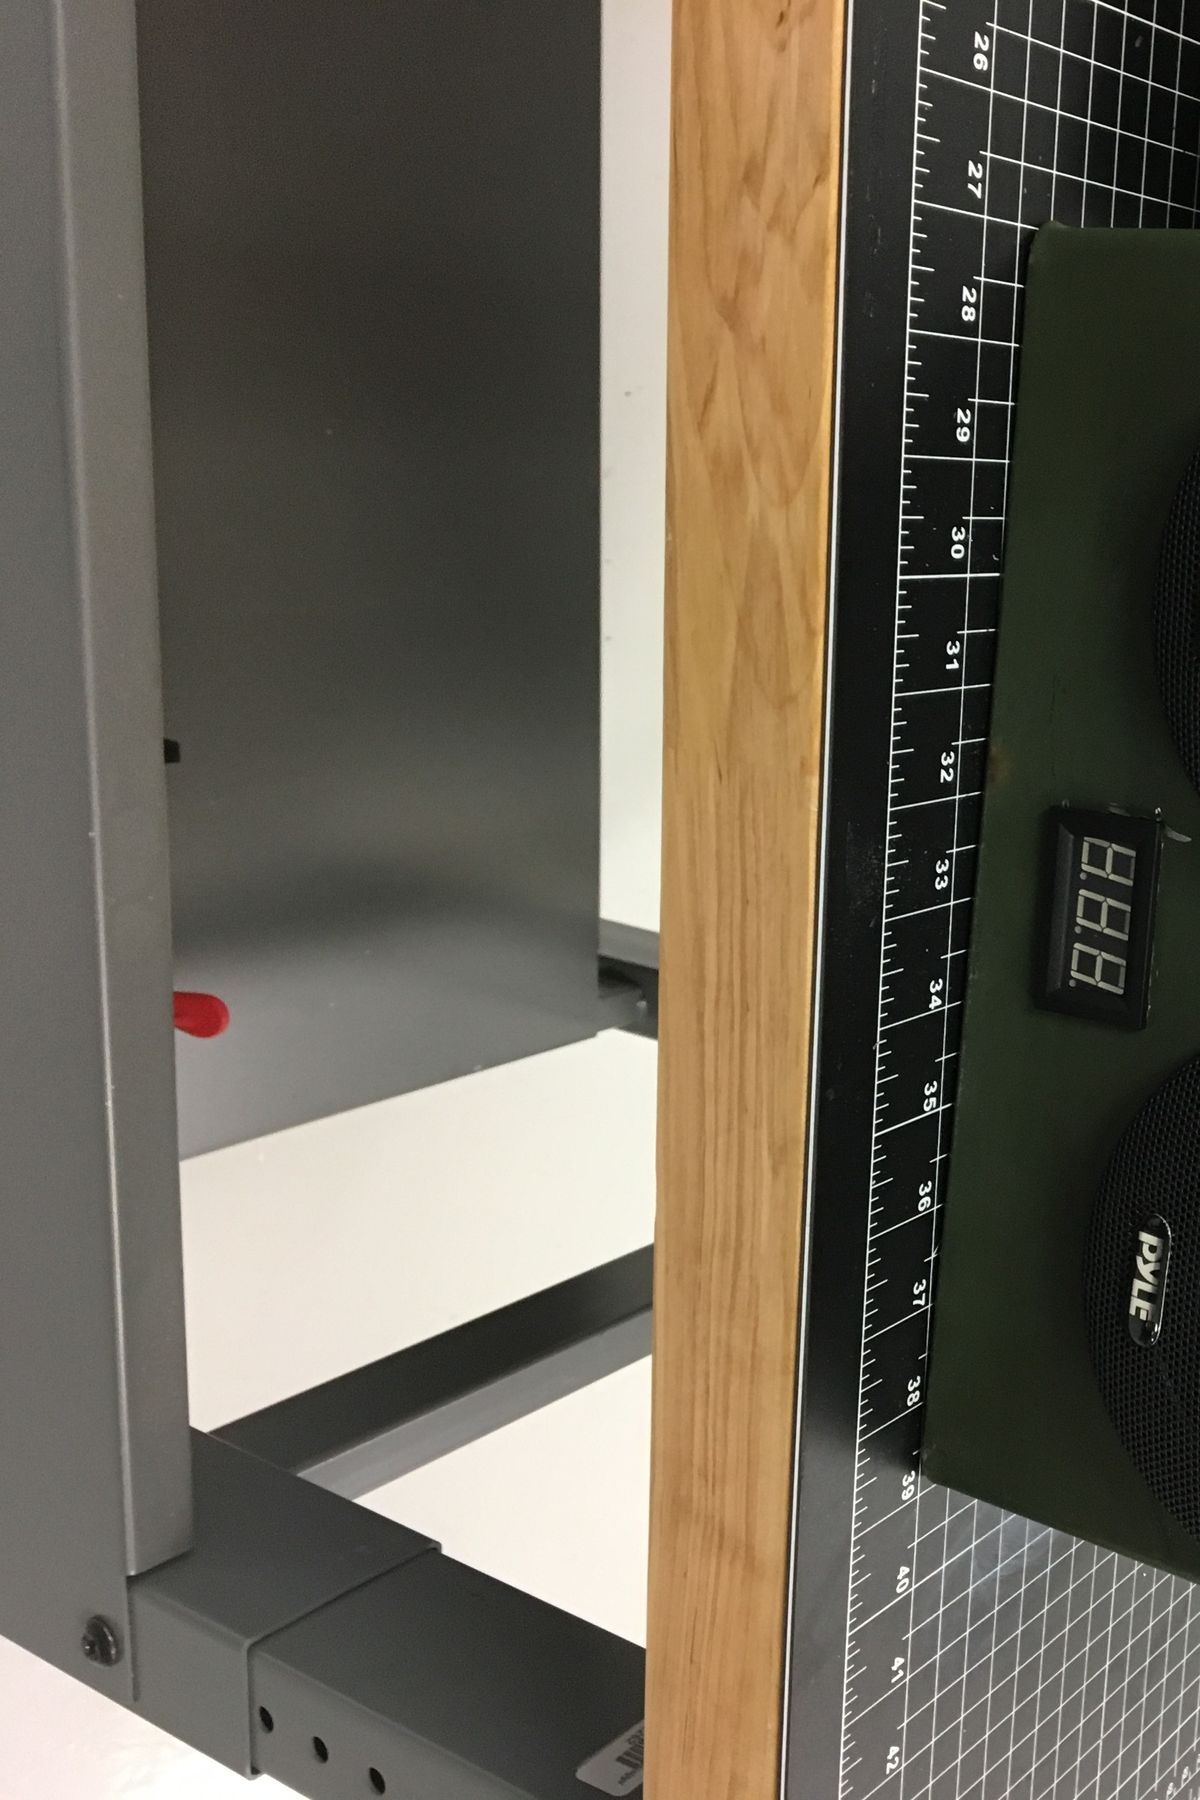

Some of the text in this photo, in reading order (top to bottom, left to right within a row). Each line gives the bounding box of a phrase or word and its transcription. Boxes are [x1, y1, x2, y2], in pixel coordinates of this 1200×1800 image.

[885, 32, 990, 1774] 26 27 28 29 30 31 32 33 34 35 36 37 38 39 40 41 42
[1129, 1230, 1164, 1321] PYLE
